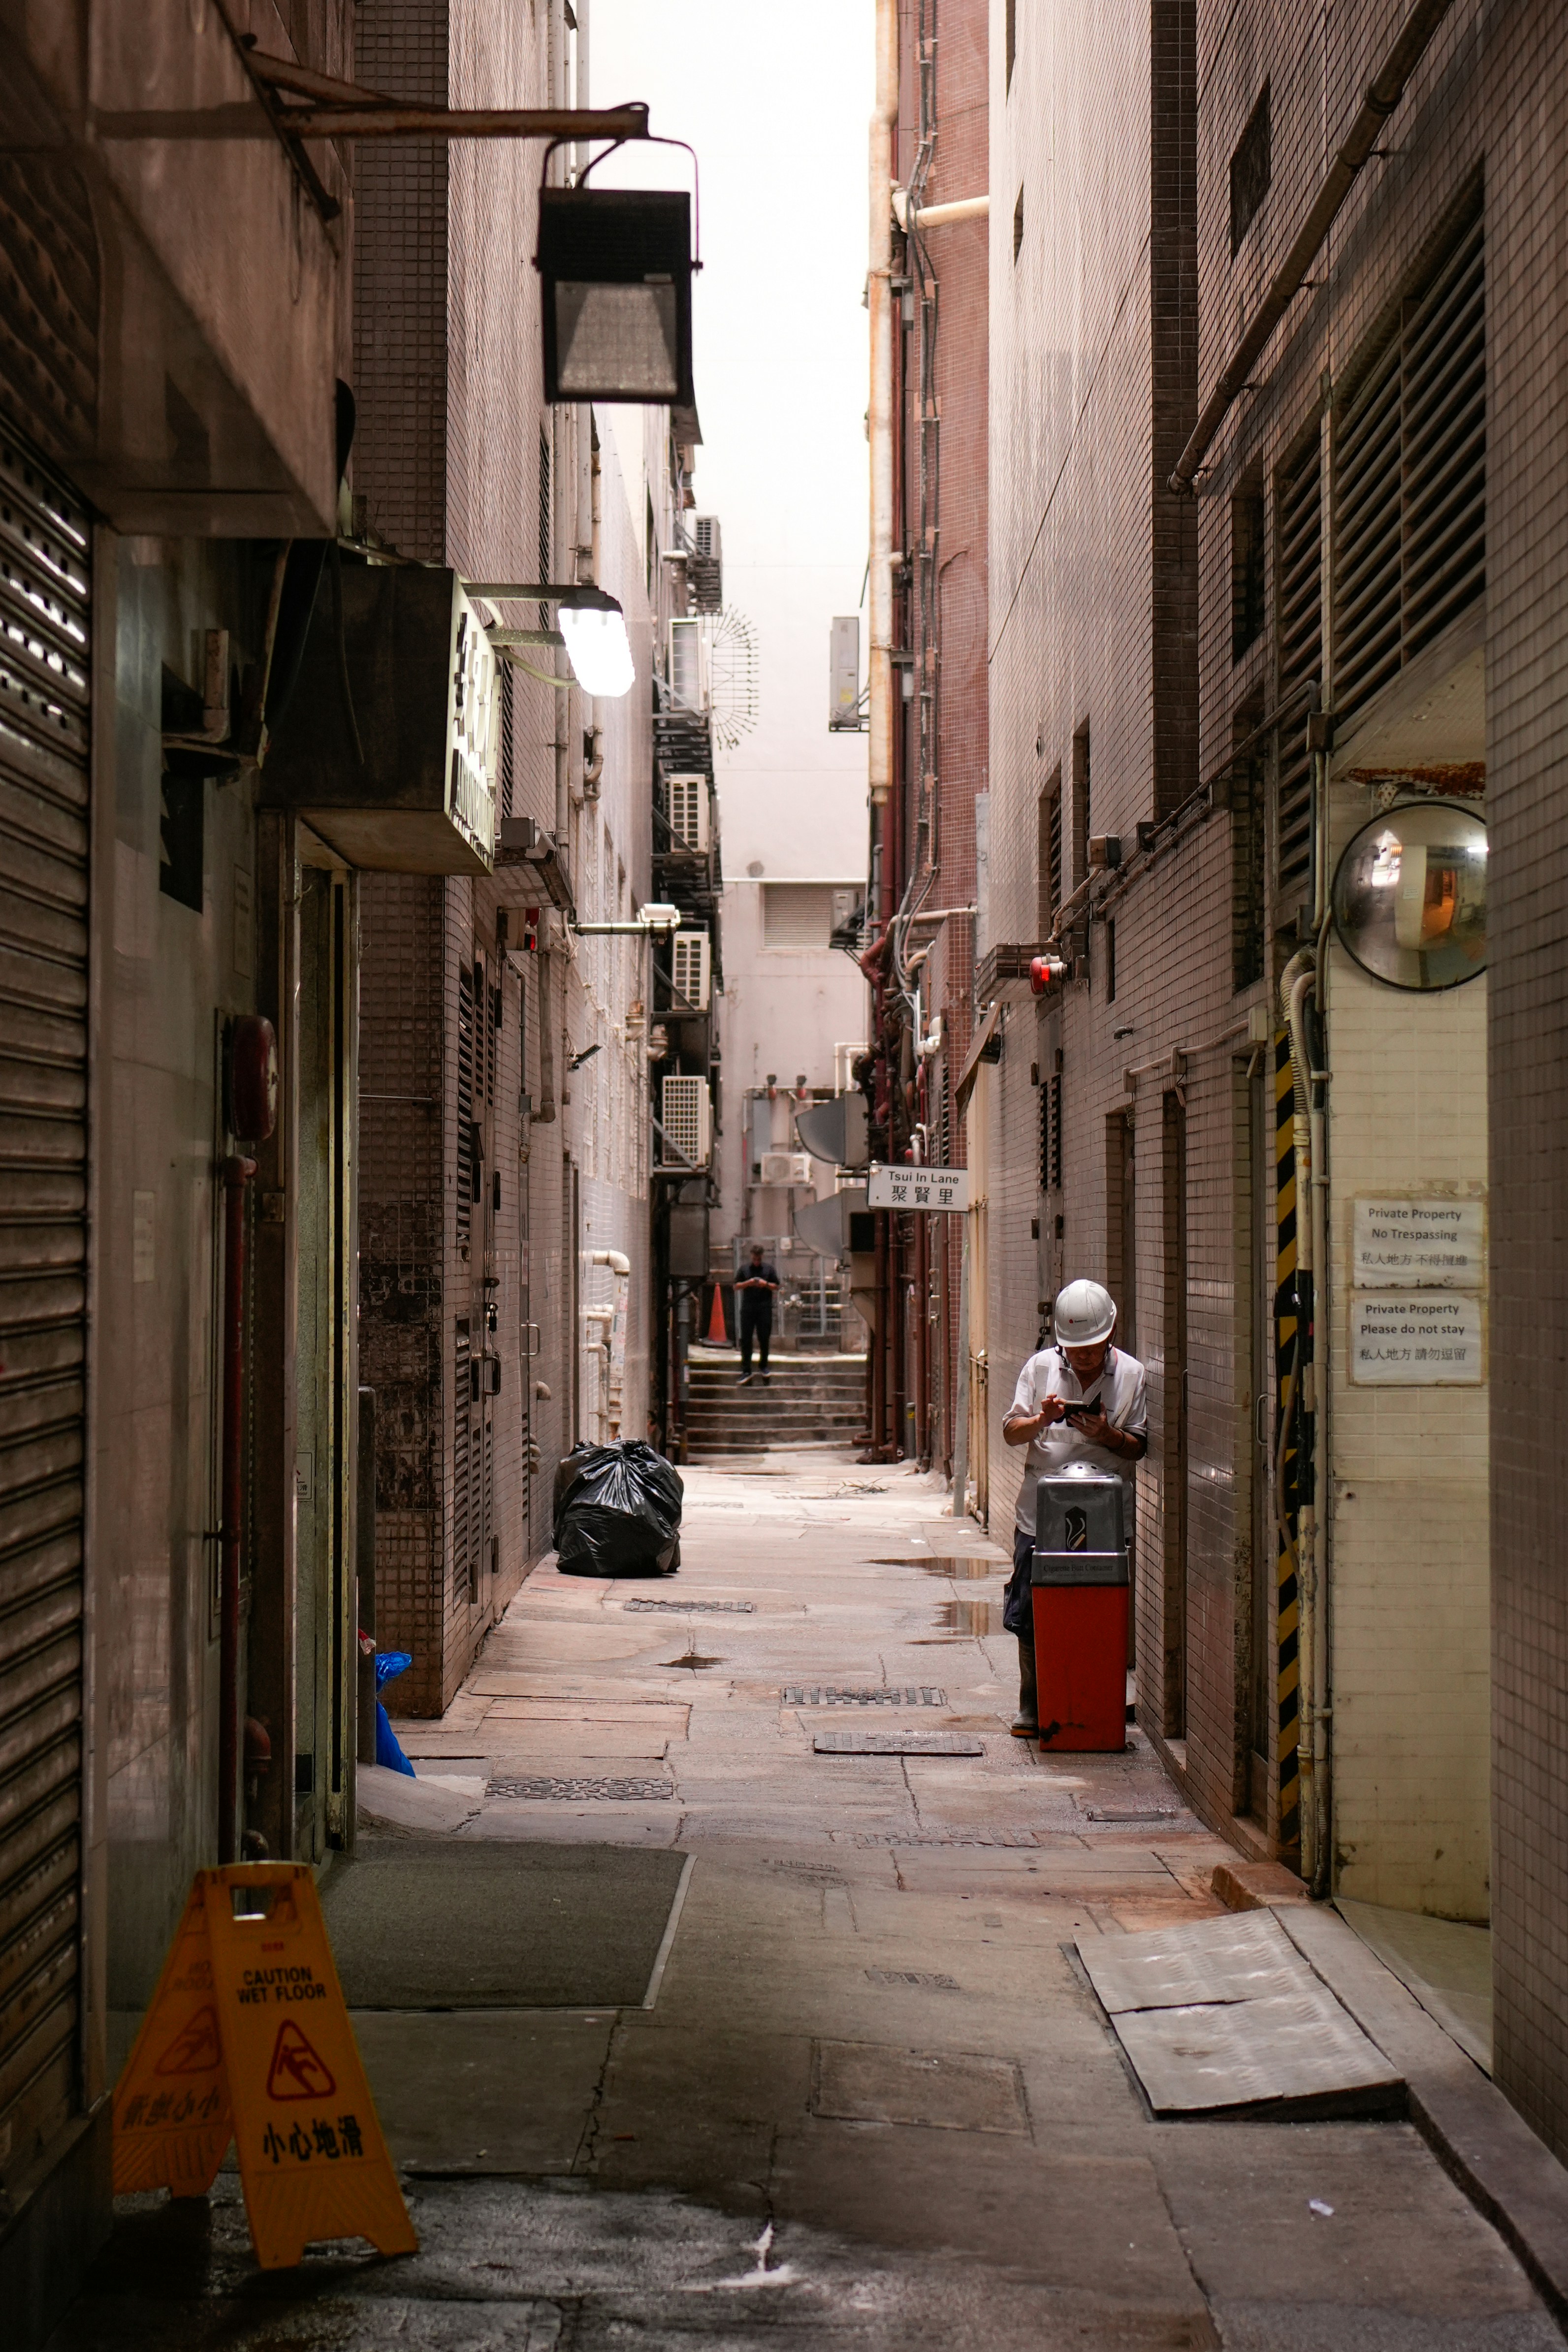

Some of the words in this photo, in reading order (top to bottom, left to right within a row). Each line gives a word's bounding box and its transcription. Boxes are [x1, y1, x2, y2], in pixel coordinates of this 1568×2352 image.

[889, 1171, 912, 1181] Tsui
[916, 1172, 927, 1182] In
[931, 1173, 959, 1184] Lane
[891, 1185, 954, 1205] 聚賢里
[1369, 1208, 1408, 1218] Private
[1411, 1209, 1462, 1222] Property
[1372, 1229, 1387, 1238] No
[1391, 1229, 1458, 1242] Trespassing
[1361, 1253, 1412, 1265] 私人地方
[1366, 1305, 1406, 1314] Private
[1409, 1304, 1459, 1315] Property
[1361, 1324, 1397, 1334] Please
[1401, 1323, 1415, 1333] do
[1419, 1325, 1438, 1333] not
[1441, 1325, 1465, 1335] stay
[1360, 1348, 1411, 1360] 私人地方
[1414, 1348, 1466, 1360] 請勿逗留
[243, 1966, 312, 1986] CAUTION
[237, 1986, 267, 2004] WET
[275, 1983, 326, 2002] FLOOR
[263, 2115, 364, 2164] 小心地滑
